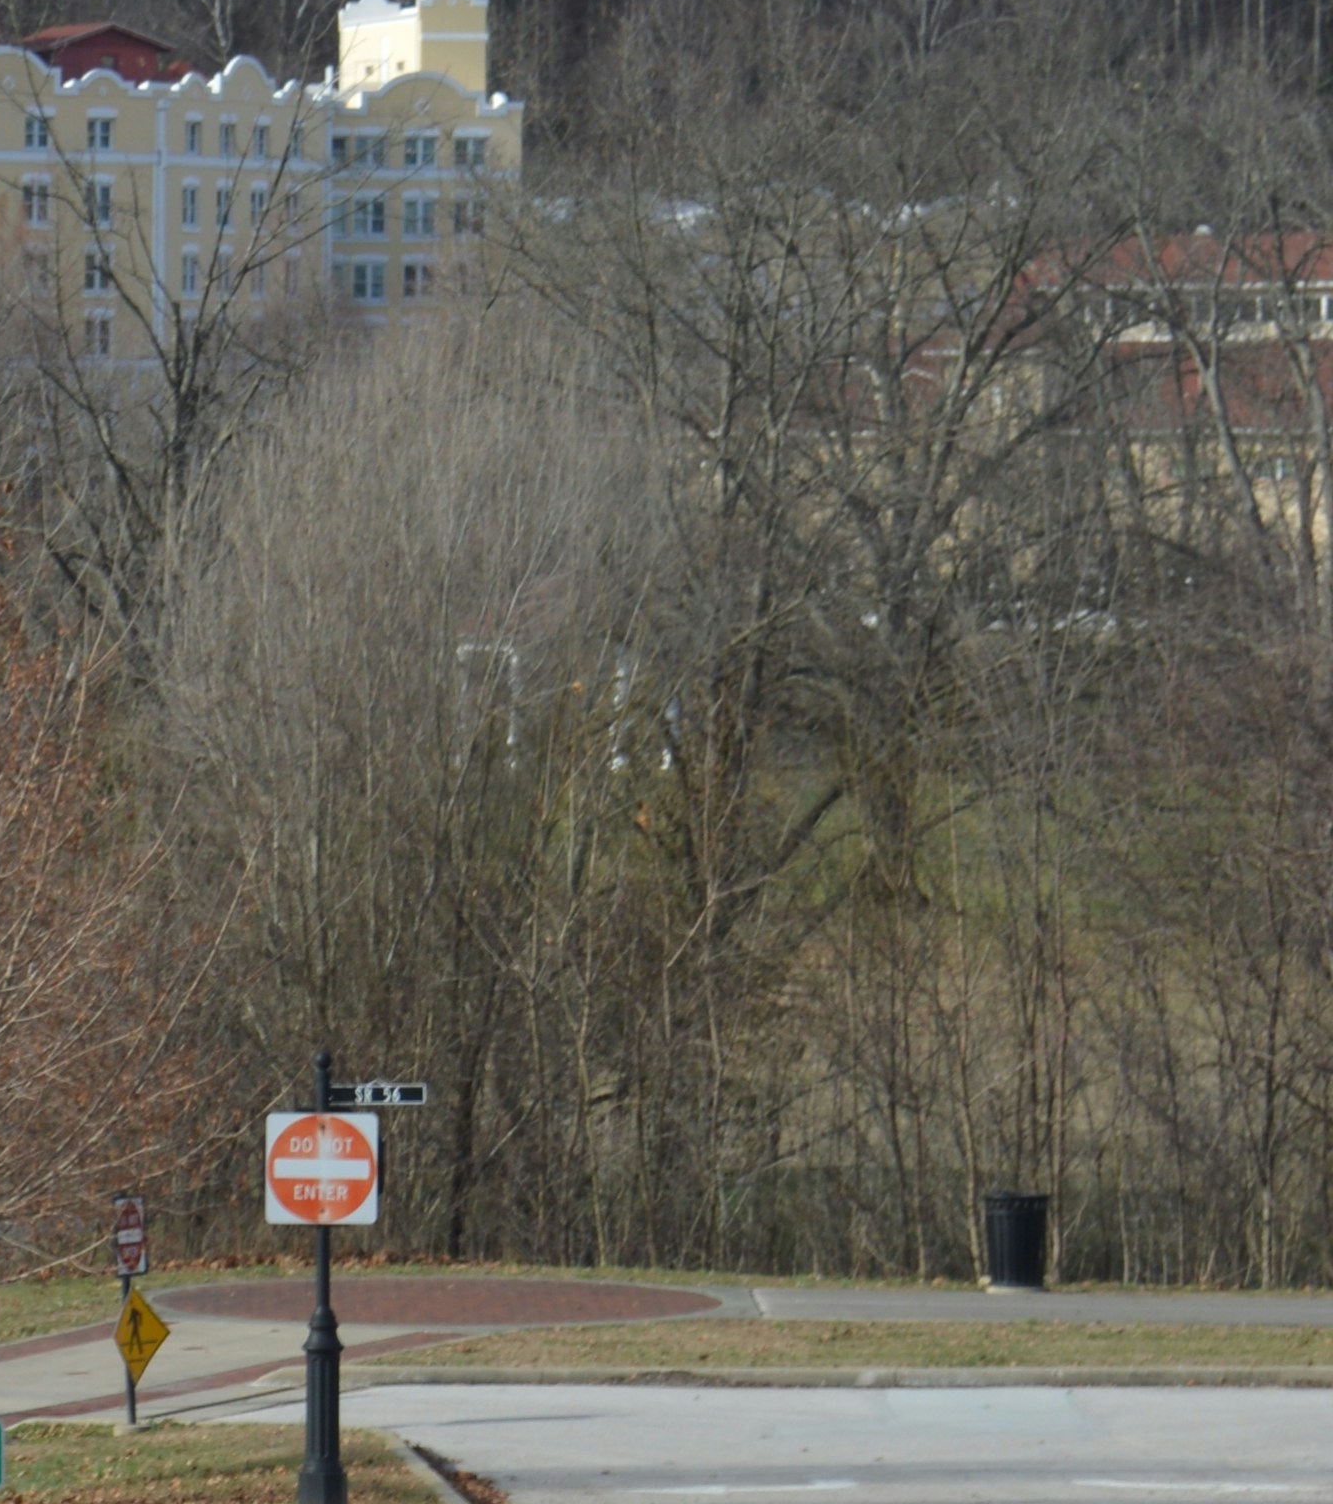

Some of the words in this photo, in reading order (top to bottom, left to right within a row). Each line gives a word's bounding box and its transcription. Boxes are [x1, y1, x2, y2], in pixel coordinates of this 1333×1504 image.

[355, 1085, 373, 1103] SR
[383, 1085, 401, 1103] 56
[289, 1137, 313, 1153] DO
[318, 1137, 354, 1154] OT
[293, 1184, 348, 1201] ENTER
